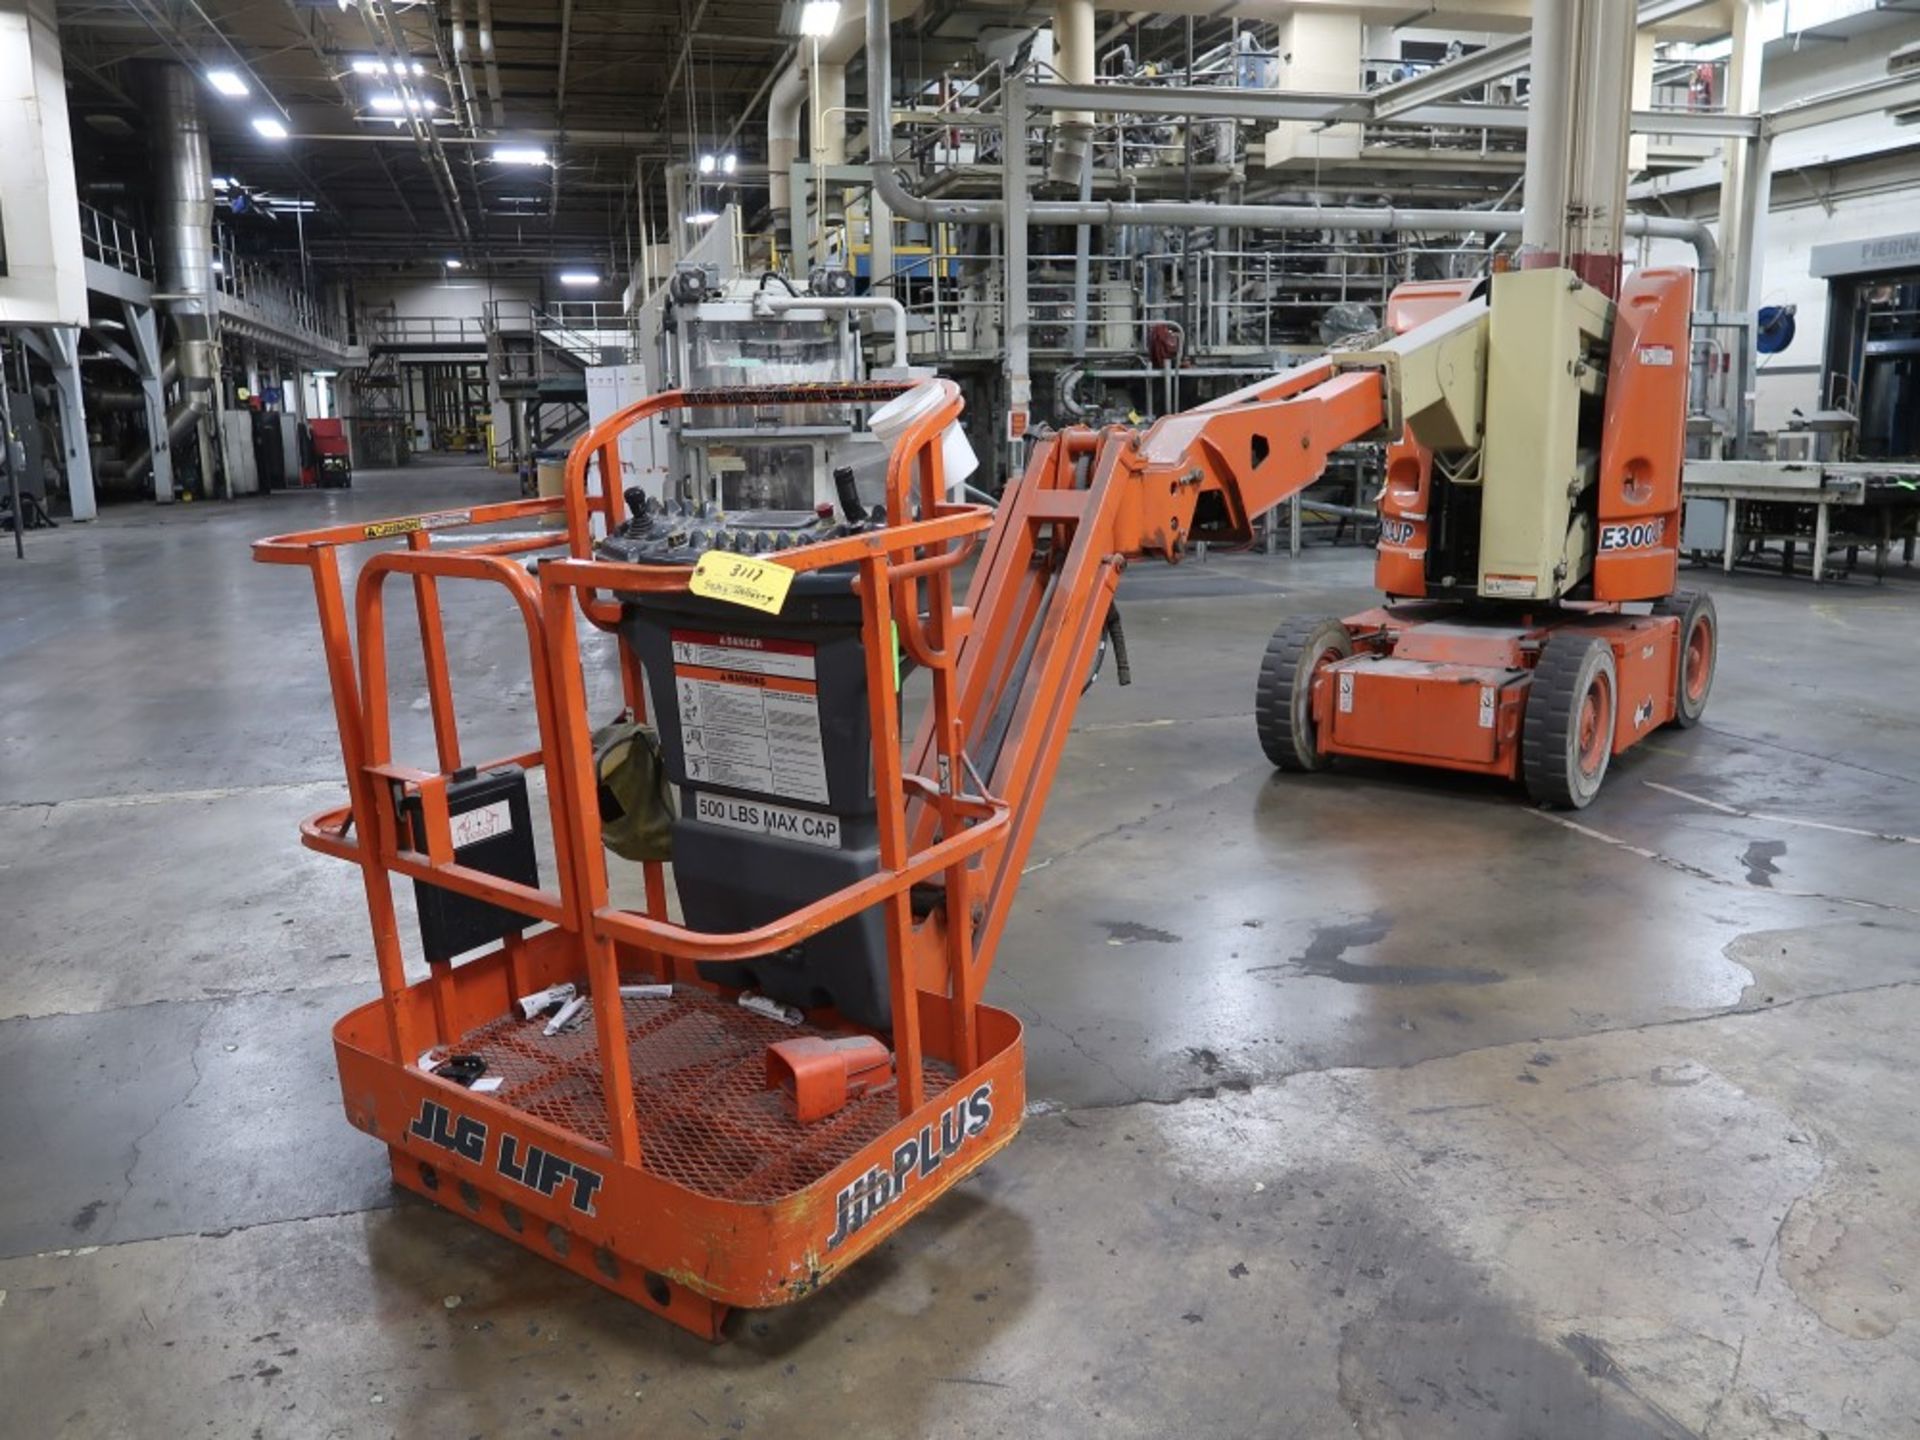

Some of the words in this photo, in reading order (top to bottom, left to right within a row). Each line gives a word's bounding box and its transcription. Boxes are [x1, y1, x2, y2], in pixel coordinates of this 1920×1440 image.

[729, 563, 763, 582] 3117
[700, 799, 725, 819] 500
[729, 803, 760, 825] LBS
[763, 810, 798, 833] MAX
[802, 816, 837, 839] CAP
[409, 1099, 488, 1165] JLG
[498, 1132, 603, 1217] LIFT
